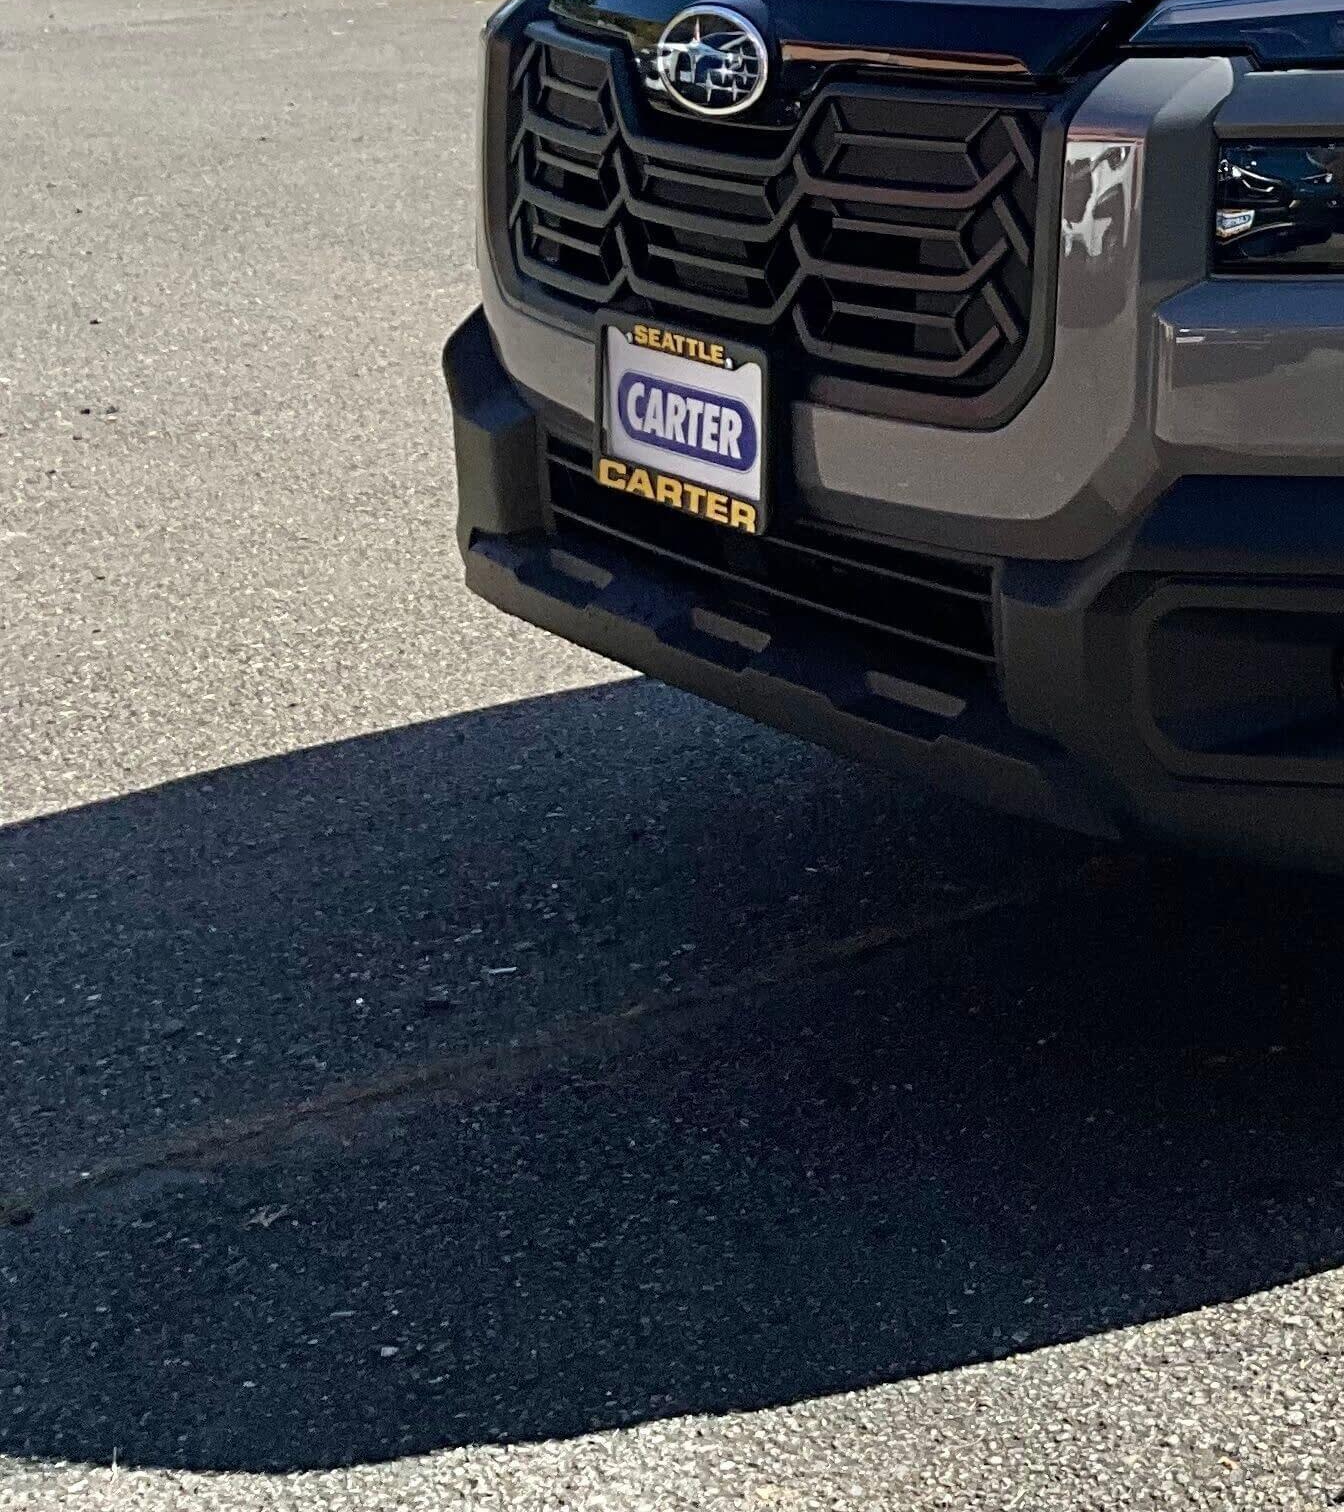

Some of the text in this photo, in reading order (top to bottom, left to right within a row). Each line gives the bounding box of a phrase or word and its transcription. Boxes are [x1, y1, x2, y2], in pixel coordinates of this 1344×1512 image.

[633, 324, 724, 365] SEATTLE
[626, 382, 742, 459] CARTER
[600, 458, 756, 534] CARTER
